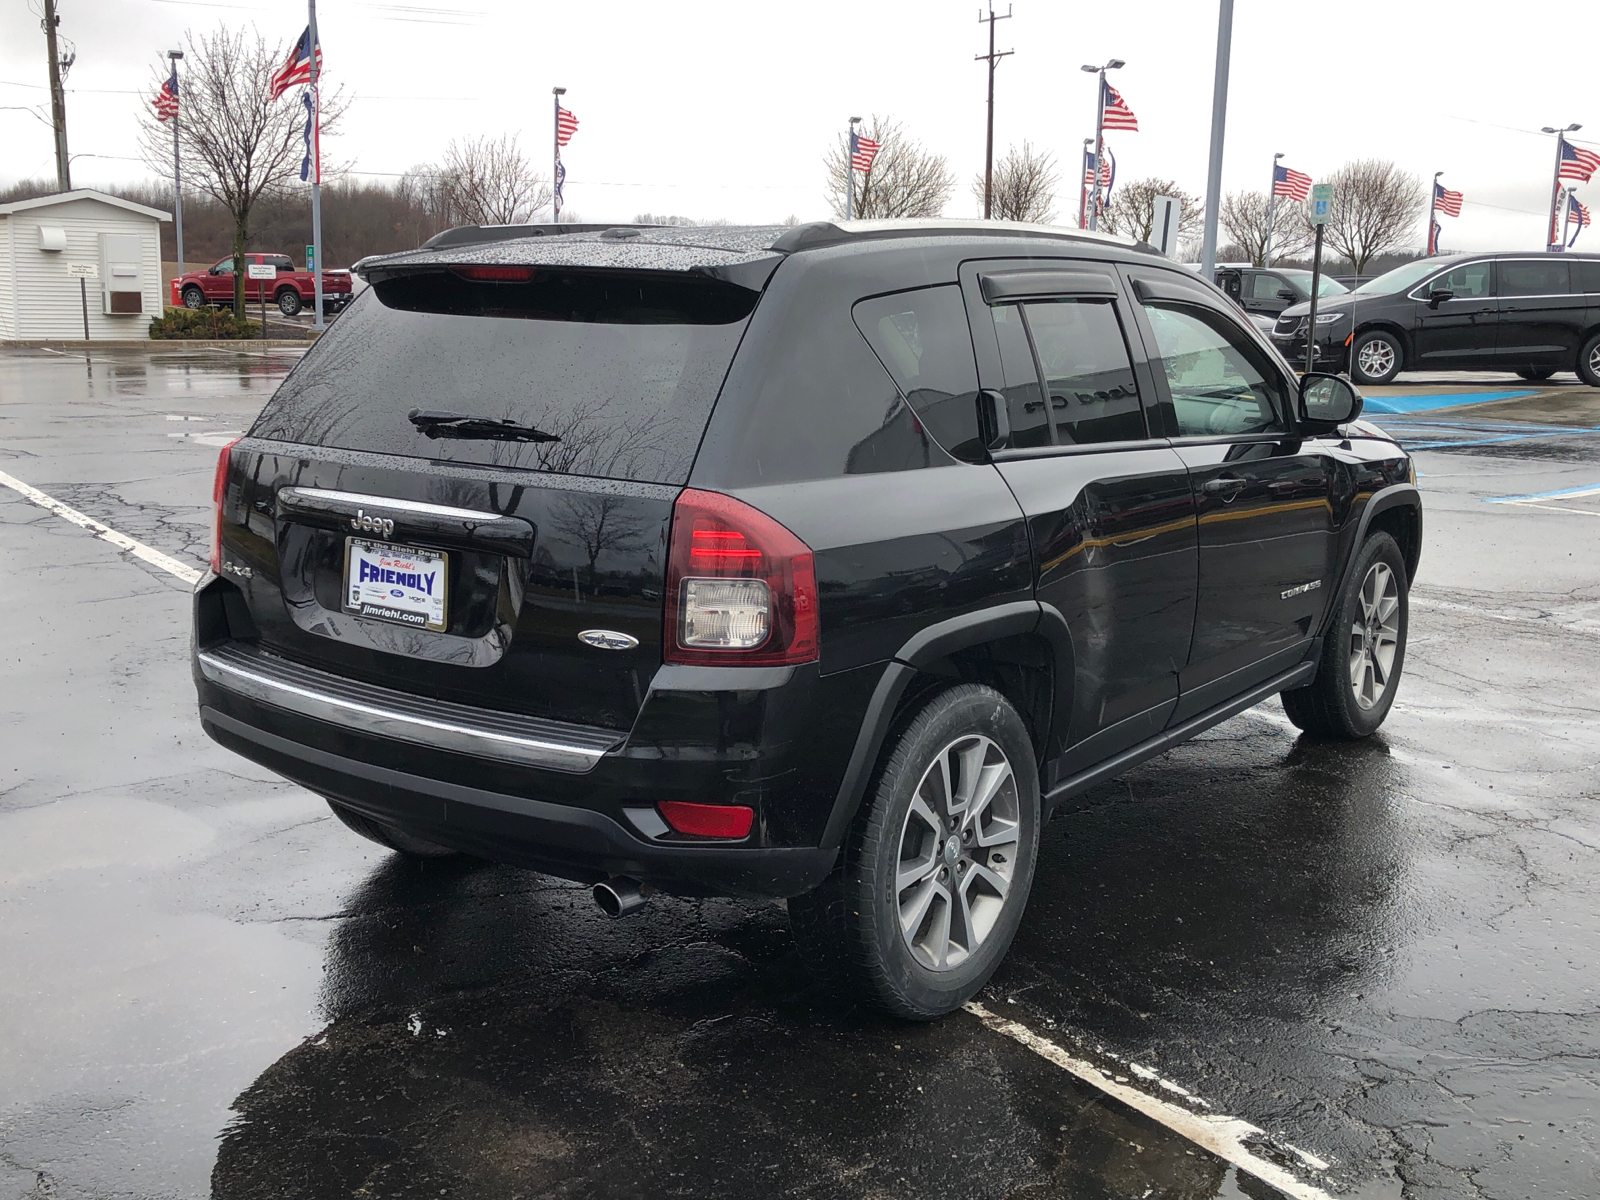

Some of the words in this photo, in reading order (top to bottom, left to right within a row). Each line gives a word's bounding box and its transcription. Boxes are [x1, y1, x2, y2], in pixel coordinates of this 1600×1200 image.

[351, 509, 394, 540] Jeep
[373, 542, 389, 550] the
[391, 545, 416, 554] Riehl
[418, 549, 440, 558] Deal
[379, 557, 392, 567] Jim
[393, 559, 416, 571] Riehl's
[360, 558, 436, 596] FRIENDLY
[1280, 579, 1322, 600] COMPASS
[362, 604, 425, 624] jimriehl.com
